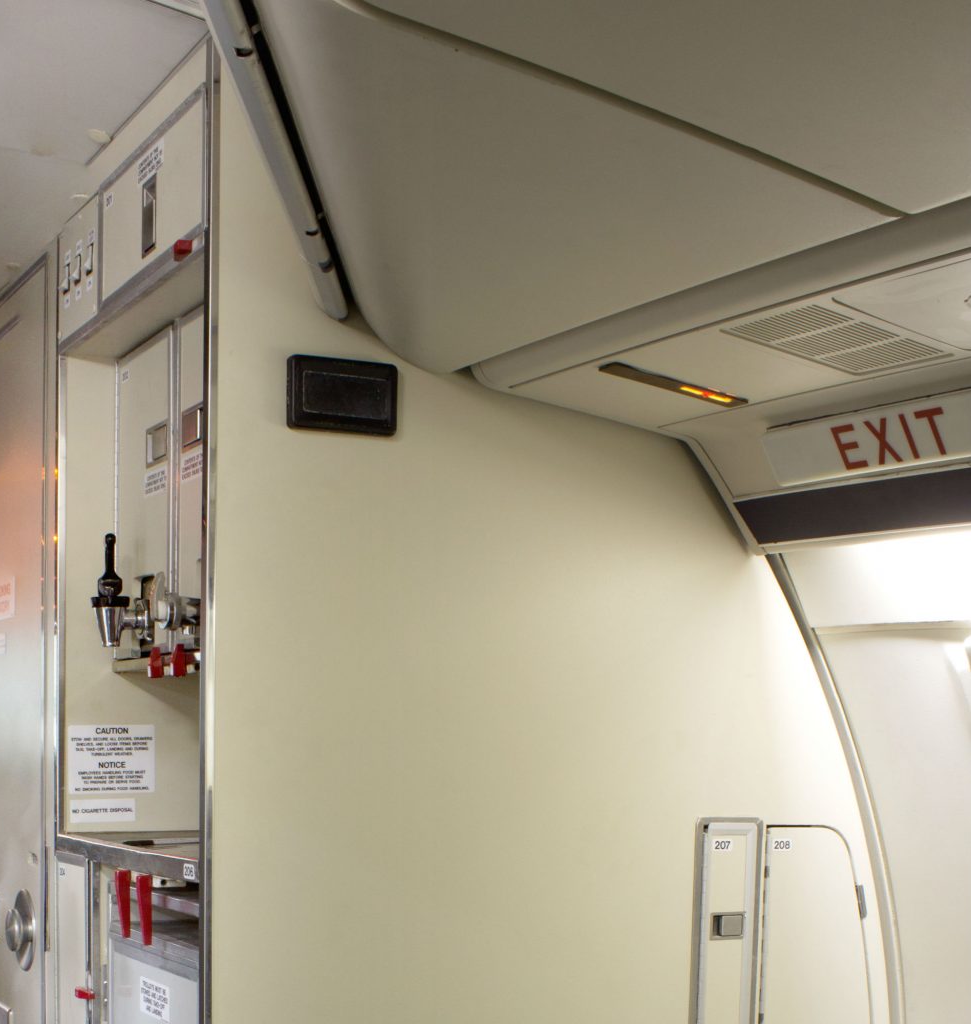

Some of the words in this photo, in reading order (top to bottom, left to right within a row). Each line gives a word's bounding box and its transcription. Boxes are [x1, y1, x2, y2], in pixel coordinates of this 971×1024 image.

[830, 406, 947, 471] EXIT
[95, 727, 129, 735] CAUTION
[98, 761, 126, 769] NOTICE
[715, 840, 730, 850] 207
[774, 840, 790, 850] 208
